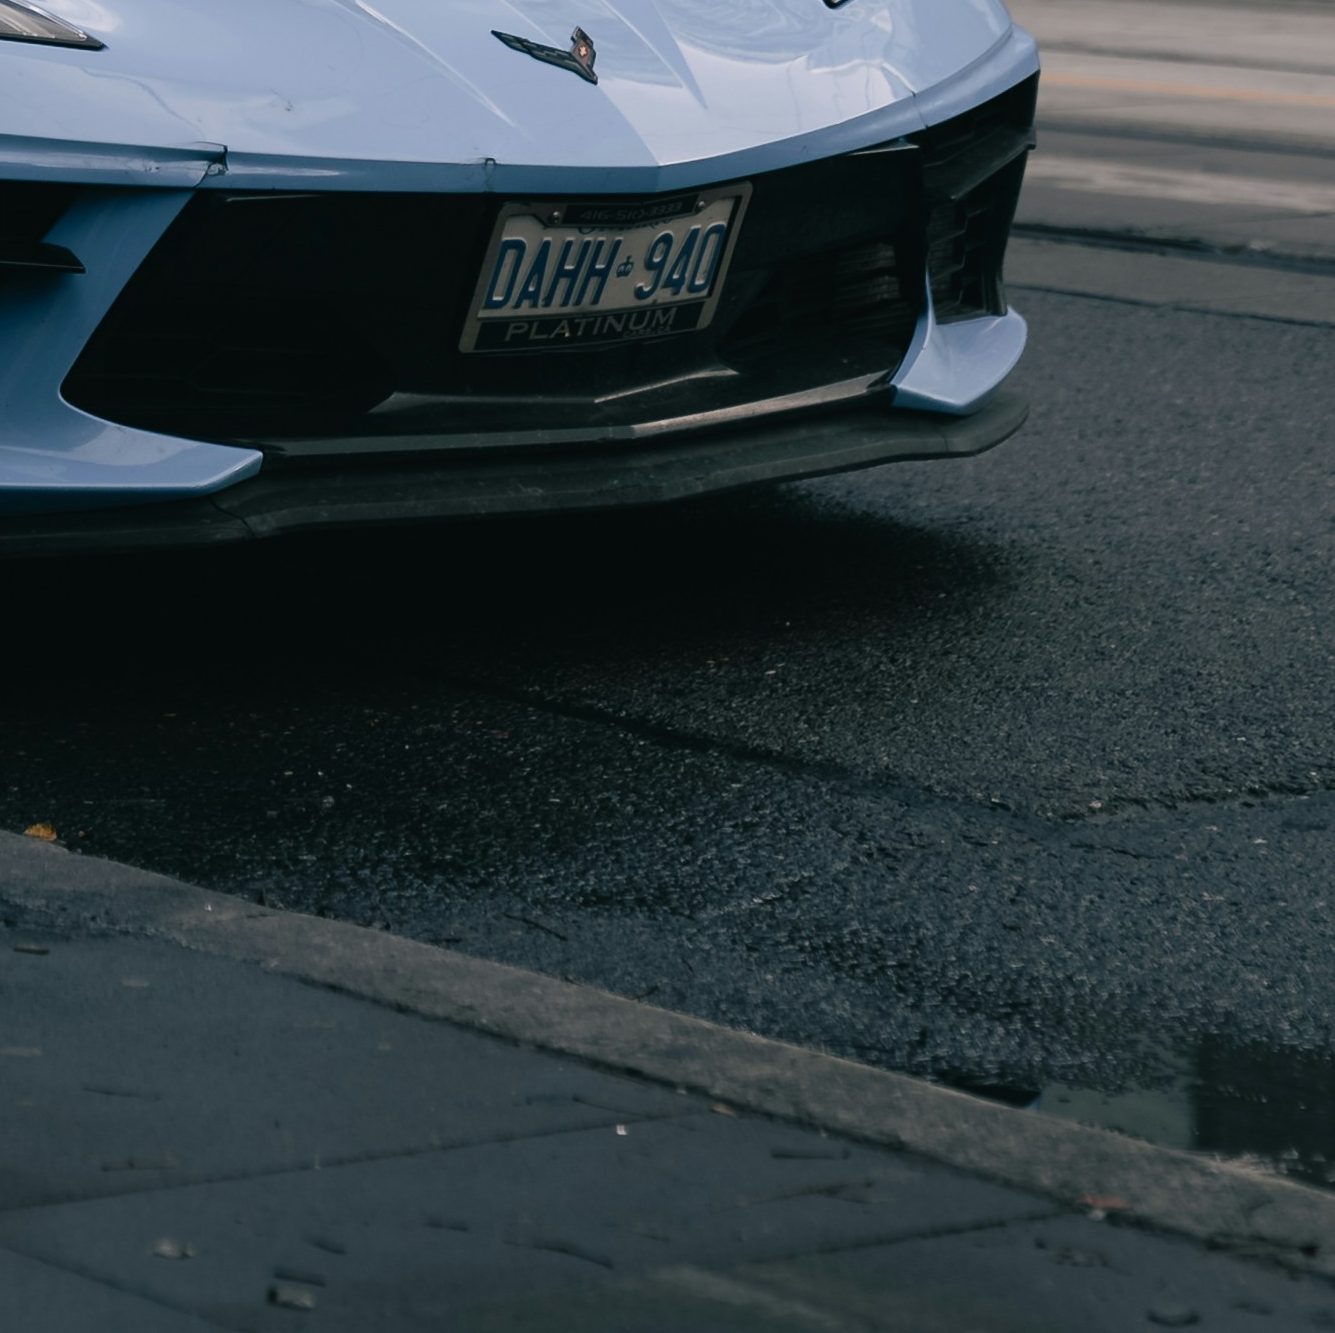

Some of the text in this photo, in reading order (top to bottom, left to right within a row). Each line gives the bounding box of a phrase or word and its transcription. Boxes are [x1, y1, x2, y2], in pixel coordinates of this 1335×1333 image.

[482, 222, 728, 310] DAHH 940
[504, 307, 679, 343] PLATINUM
